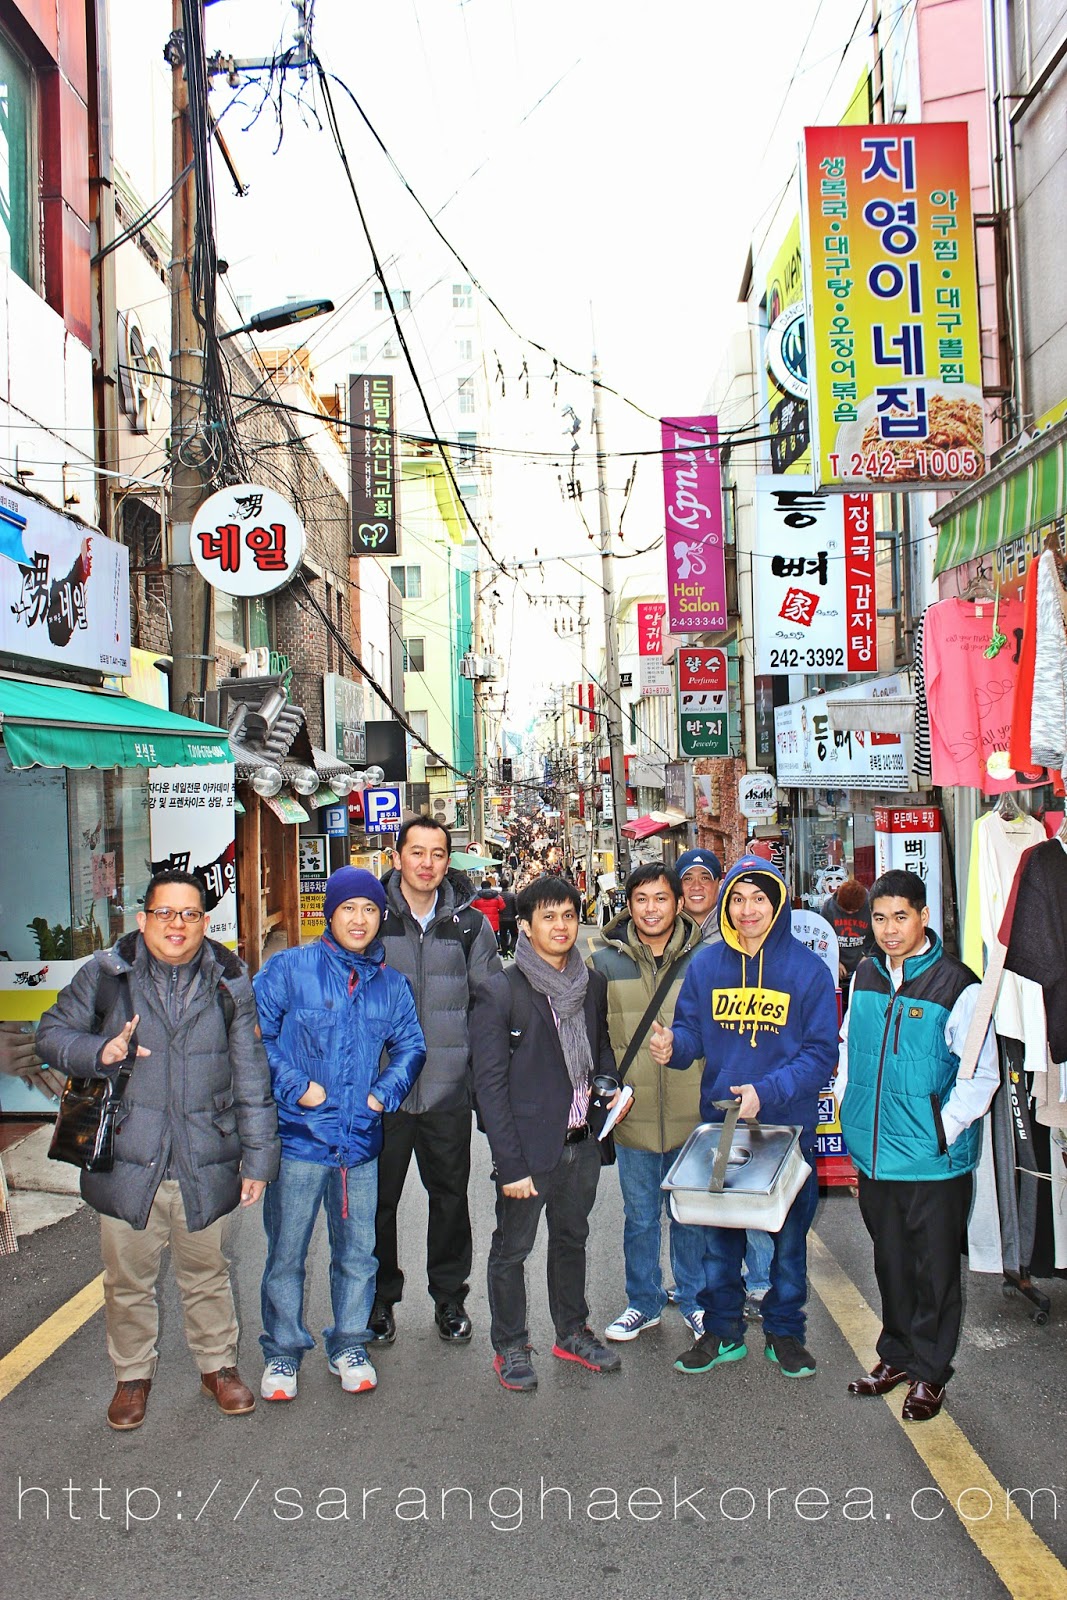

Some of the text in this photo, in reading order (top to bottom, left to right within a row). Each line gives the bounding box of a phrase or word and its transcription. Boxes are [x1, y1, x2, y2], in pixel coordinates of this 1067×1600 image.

[930, 189, 958, 262] 아구찜
[820, 156, 859, 424] 생복국 대구탕 오징어볶음
[861, 136, 931, 442] 지영이네집
[829, 450, 977, 479] T.242-1005
[668, 425, 715, 530] Trudy
[198, 523, 289, 572] 네일
[673, 582, 706, 598] Hair
[59, 581, 88, 630] 네일
[679, 597, 720, 613] Salon
[644, 612, 662, 653] 양귀비
[850, 584, 873, 662] 감자탕
[684, 656, 722, 673] 향수
[770, 648, 844, 668] 242-3392
[688, 676, 719, 685] Perfume
[686, 720, 722, 736] 반지
[691, 739, 719, 749] Jewelry
[172, 782, 201, 794] 네일전문
[202, 782, 230, 793] 아카데미
[745, 787, 773, 800] Asahi
[367, 790, 397, 823] P
[330, 812, 341, 826] P
[922, 811, 934, 828] 포장
[715, 993, 785, 1019] Dickies
